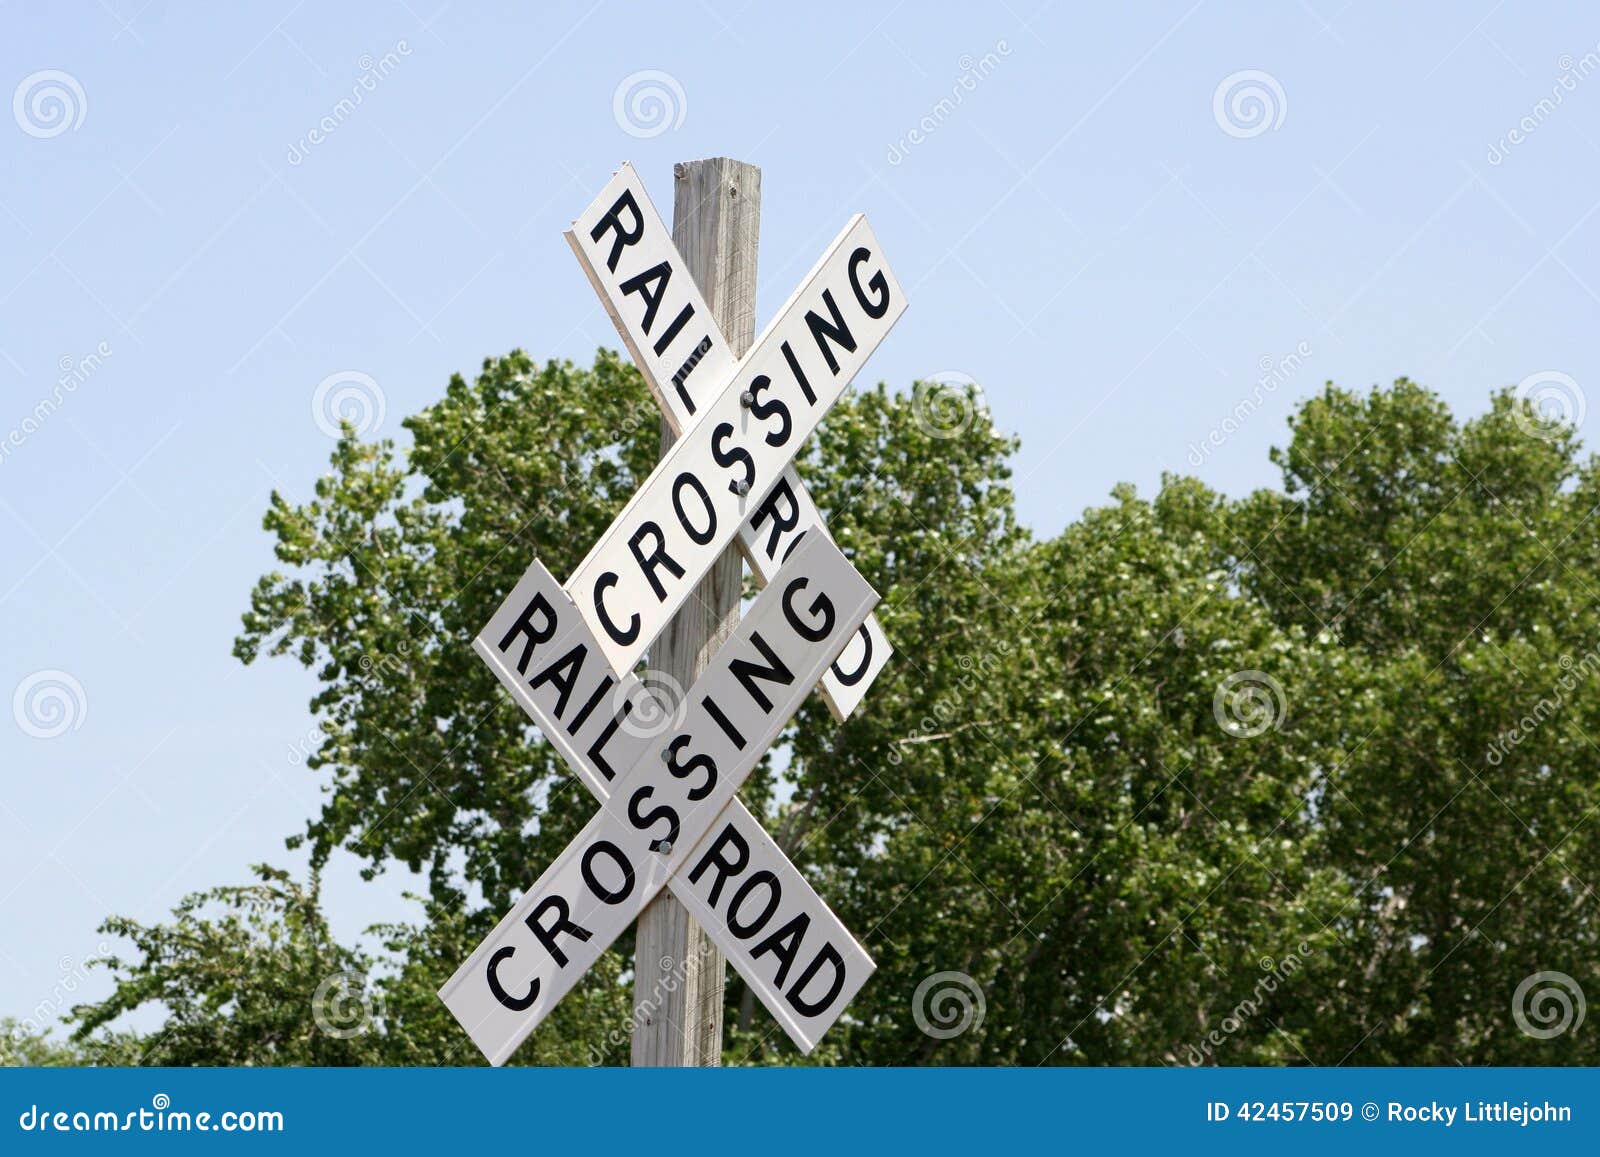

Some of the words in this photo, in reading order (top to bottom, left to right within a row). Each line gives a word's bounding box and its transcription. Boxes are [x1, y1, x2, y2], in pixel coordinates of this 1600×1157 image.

[590, 188, 713, 417] RAIL
[593, 246, 891, 648] CROSSING
[486, 576, 837, 1012] CROSSING
[498, 591, 633, 782] RAIL
[688, 823, 847, 1019] ROAD
